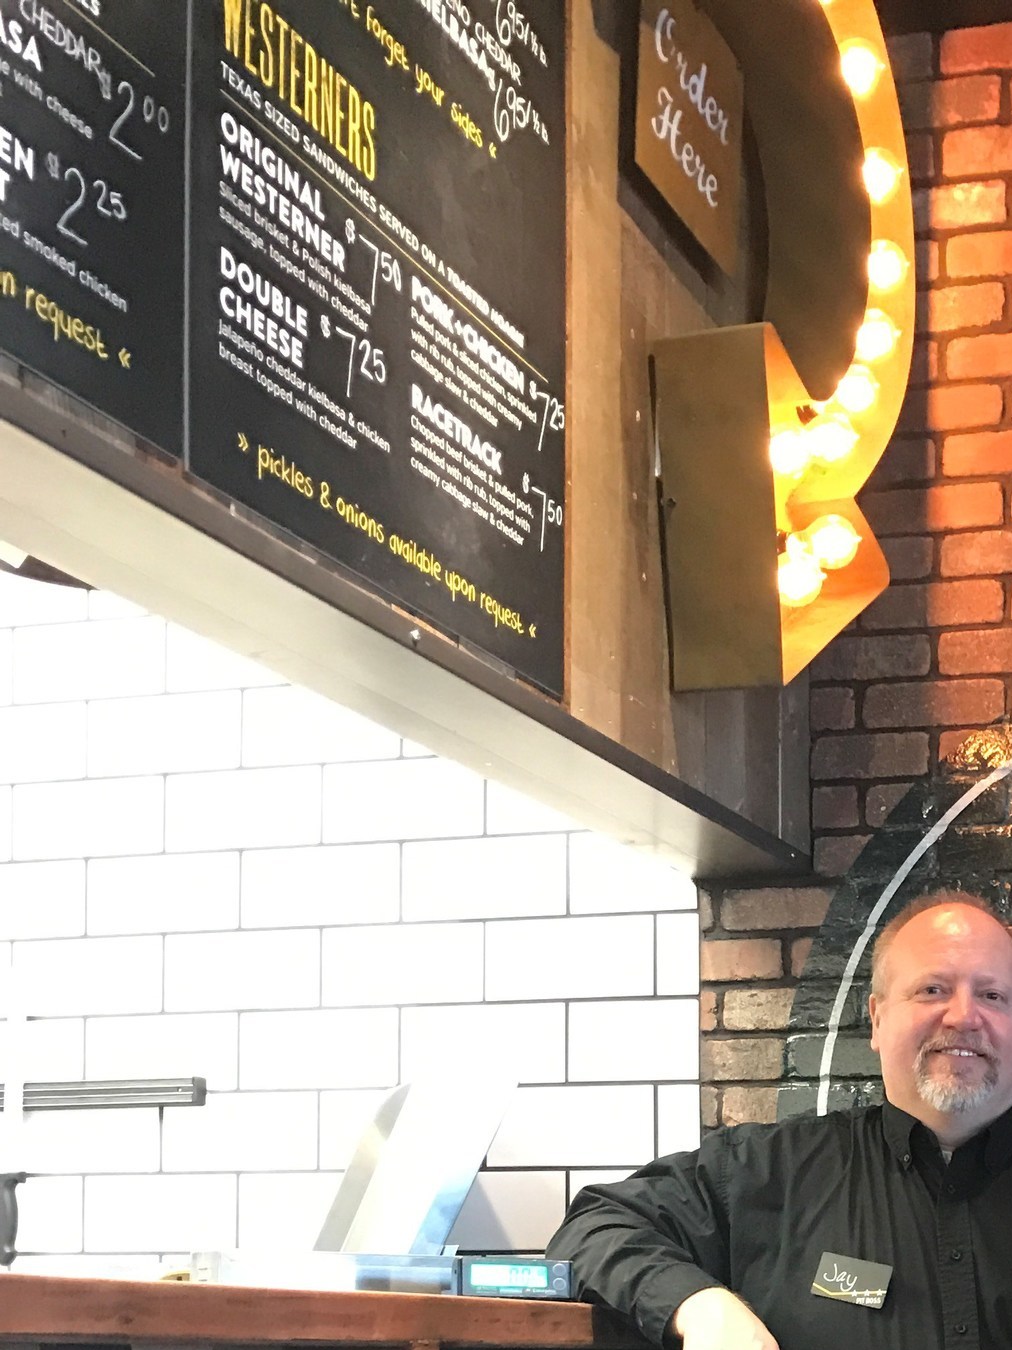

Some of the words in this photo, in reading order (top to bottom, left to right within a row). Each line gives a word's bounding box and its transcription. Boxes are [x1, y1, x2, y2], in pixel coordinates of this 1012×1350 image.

[223, 0, 376, 182] WESTERNERS
[366, 5, 410, 71] forget
[415, 63, 445, 107] your
[451, 102, 484, 149] sides
[475, 22, 522, 87] CHEDDAR
[655, 8, 728, 146] Order
[46, 95, 93, 140] cheese
[651, 86, 719, 208] Here
[219, 143, 346, 273] WESTERNER
[220, 111, 326, 222] ORIGINAL
[220, 60, 262, 110] TEXAS
[264, 100, 301, 144] SIZED
[302, 134, 378, 214] SANDWICHES
[378, 203, 420, 252] SERVED
[421, 243, 437, 269] ON
[437, 259, 446, 277] A
[23, 230, 76, 278] smoked
[78, 269, 128, 313] chicken
[220, 246, 309, 338] DOUBLE
[253, 208, 291, 250] brisket
[291, 239, 301, 258] &
[302, 246, 332, 283] Polish
[332, 271, 372, 316] kielbasa
[269, 243, 306, 284] topped
[307, 275, 330, 302] with
[330, 295, 370, 333] cheddar
[25, 285, 109, 361] request
[219, 286, 304, 370] CHEESE
[218, 341, 255, 379] breast
[256, 368, 293, 406] topped
[295, 398, 318, 423] with
[318, 414, 358, 450] cheddar
[265, 354, 307, 392] cheddar
[307, 381, 347, 422] kielbasa
[347, 411, 356, 428] &
[356, 420, 392, 454] chicken
[411, 383, 502, 476] RACETRACK
[410, 414, 445, 451] Chopped
[445, 440, 463, 463] beef
[463, 453, 488, 484] brisket
[410, 436, 446, 471] sprinkled
[445, 462, 463, 483] with
[488, 493, 515, 521] topped
[410, 456, 441, 488] creamy
[441, 479, 472, 509] cabbage
[471, 501, 489, 521] slaw
[258, 443, 314, 498] pickles
[320, 481, 334, 510] &
[335, 496, 385, 544] onions
[389, 533, 442, 582] available
[444, 569, 476, 602] upon
[480, 591, 525, 635] request
[822, 1262, 858, 1293] Jay
